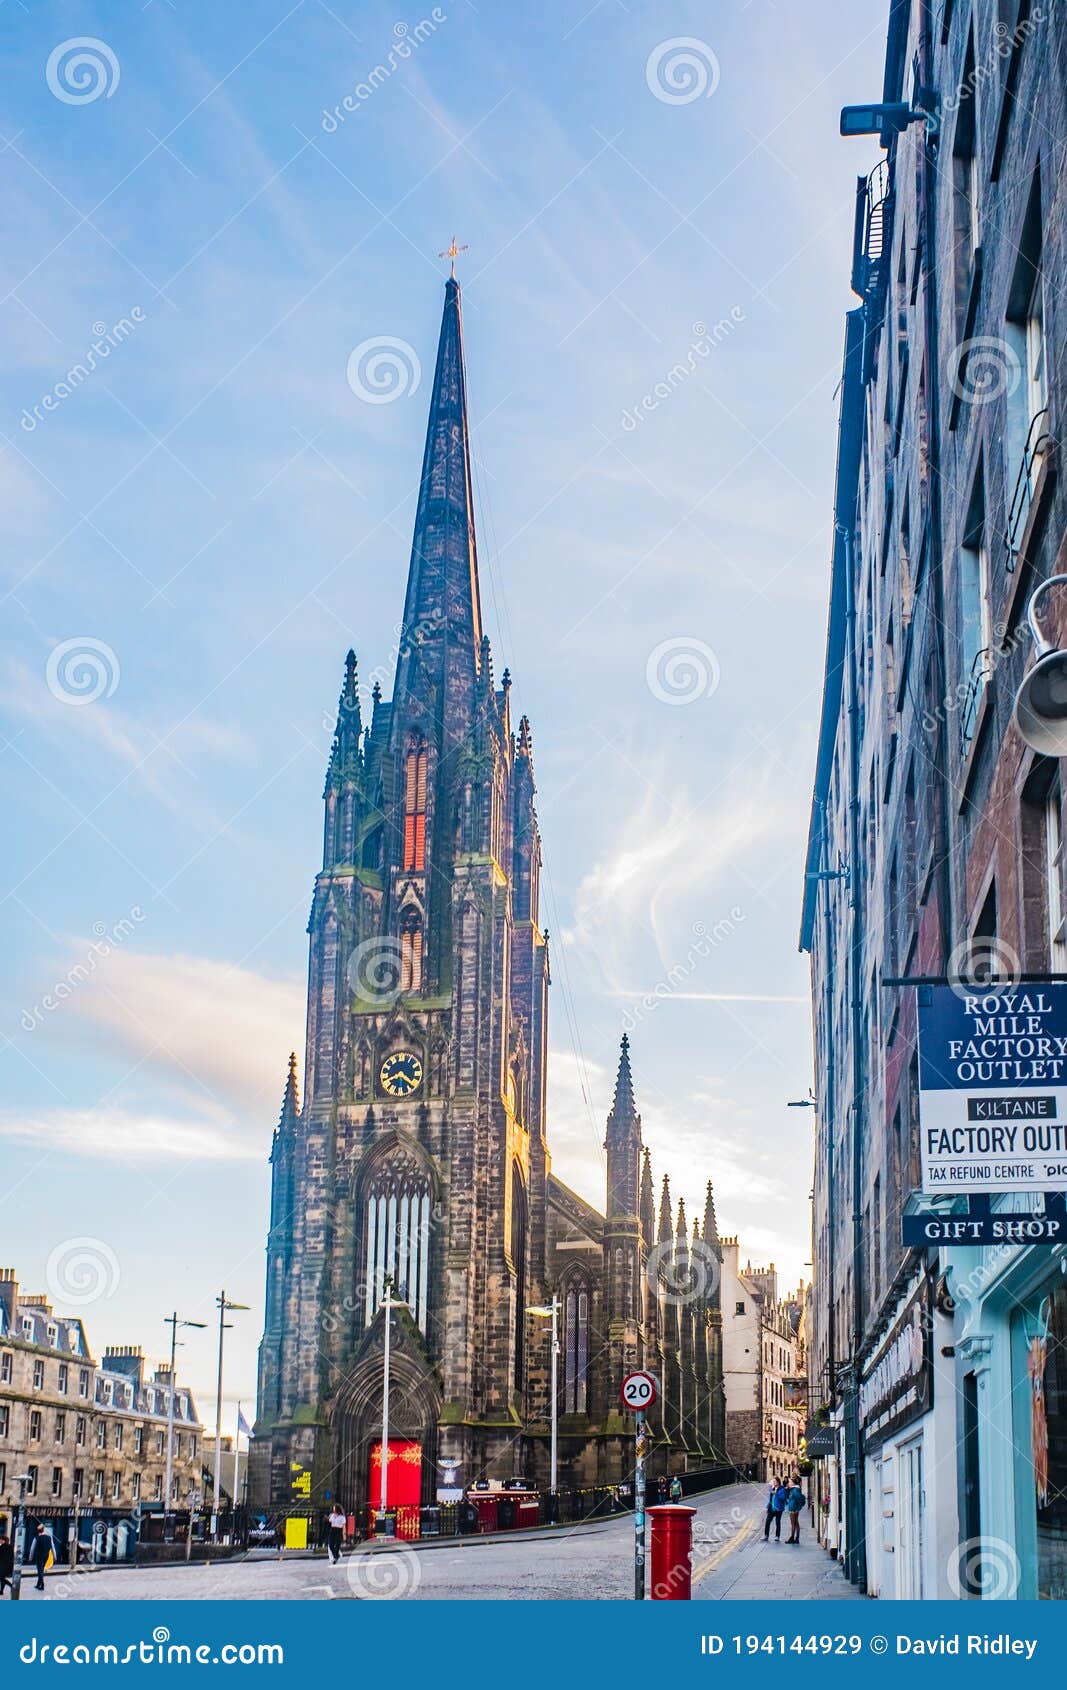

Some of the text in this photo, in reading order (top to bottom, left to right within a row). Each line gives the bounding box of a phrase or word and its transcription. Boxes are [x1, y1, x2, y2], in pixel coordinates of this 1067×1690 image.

[963, 994, 1052, 1016] ROYAL
[973, 1016, 1043, 1037] MILE
[948, 1037, 1067, 1060] FACTORY
[956, 1059, 1064, 1081] OUTLET
[976, 1100, 1048, 1117] KILTANE
[927, 1125, 1067, 1155] FACTORY OUT
[928, 1164, 1034, 1180] TAX REFUND CENTRE
[924, 1220, 1061, 1239] GIFT SHOP
[626, 1383, 650, 1399] 20
